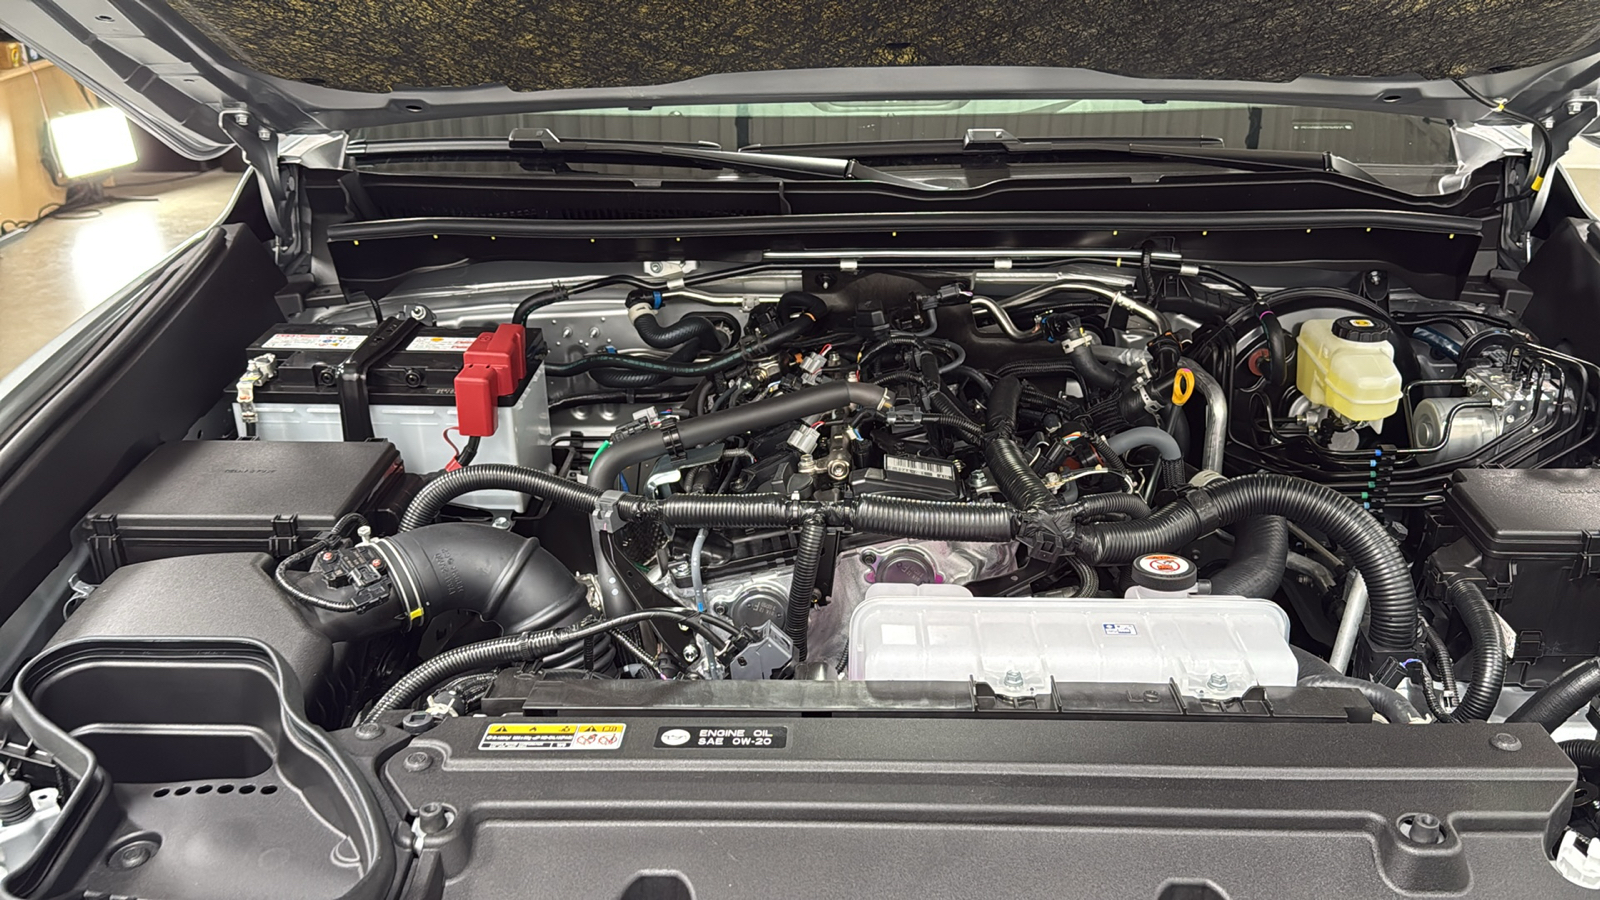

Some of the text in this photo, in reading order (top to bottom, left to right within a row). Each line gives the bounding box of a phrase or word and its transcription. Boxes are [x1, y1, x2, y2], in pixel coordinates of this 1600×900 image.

[699, 729, 773, 737] ENGINE OIL
[697, 737, 772, 745] SAE 0W-20
